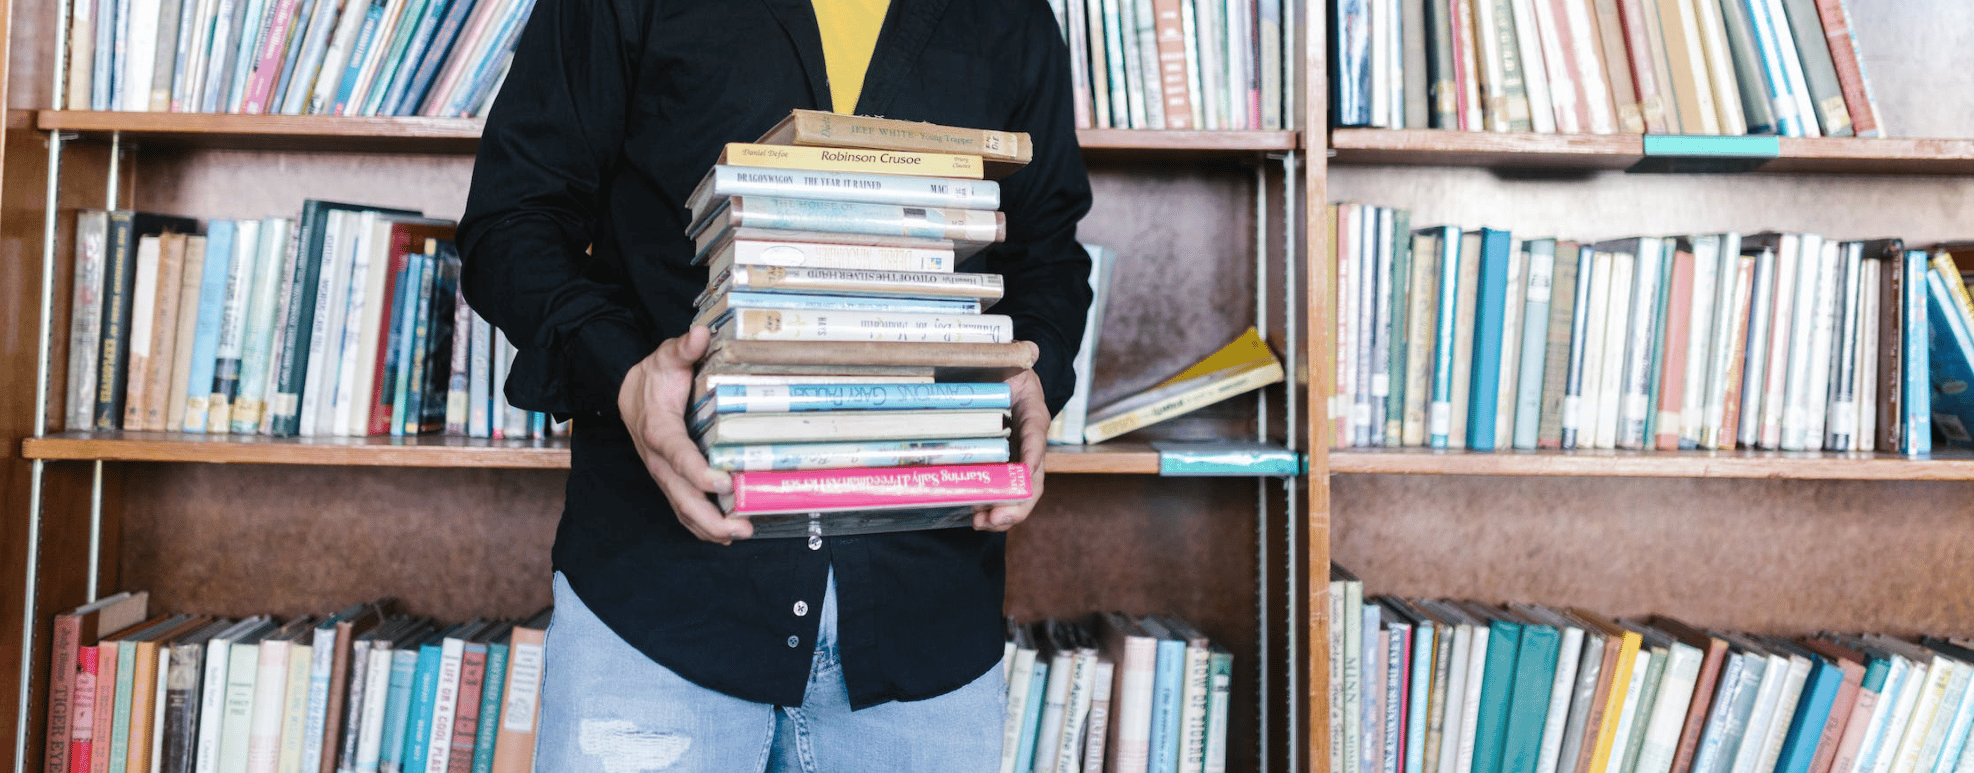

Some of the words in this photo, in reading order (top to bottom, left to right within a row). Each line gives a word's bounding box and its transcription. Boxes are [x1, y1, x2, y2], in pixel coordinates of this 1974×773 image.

[880, 127, 914, 138] WHITE
[742, 148, 766, 158] Daniel
[768, 149, 788, 158] Defoe
[821, 150, 876, 164] Robinson
[880, 153, 922, 165] Crusoe
[736, 172, 794, 185] DRAGONWAGON
[804, 176, 819, 186] THE
[821, 177, 841, 188] YEAR
[843, 178, 851, 188] IT
[852, 179, 882, 190] RAINED
[807, 270, 837, 280] HAND
[838, 272, 874, 281] SILVER
[874, 273, 898, 282] THE
[898, 274, 912, 282] OF
[817, 317, 827, 336] HAYS
[934, 318, 952, 342] Boy
[846, 386, 887, 406] GARY
[896, 384, 974, 406] CANYONS
[912, 472, 939, 486] Sally
[940, 470, 991, 484] Starring
[443, 662, 454, 682] LIFE
[1073, 656, 1085, 679] Two
[1192, 658, 1208, 688] ROW
[1345, 657, 1356, 703] MINN
[50, 684, 68, 736] TIGER
[1064, 682, 1084, 729] Against
[1190, 694, 1206, 709] OF
[435, 715, 448, 741] COOL
[1061, 731, 1074, 750] the
